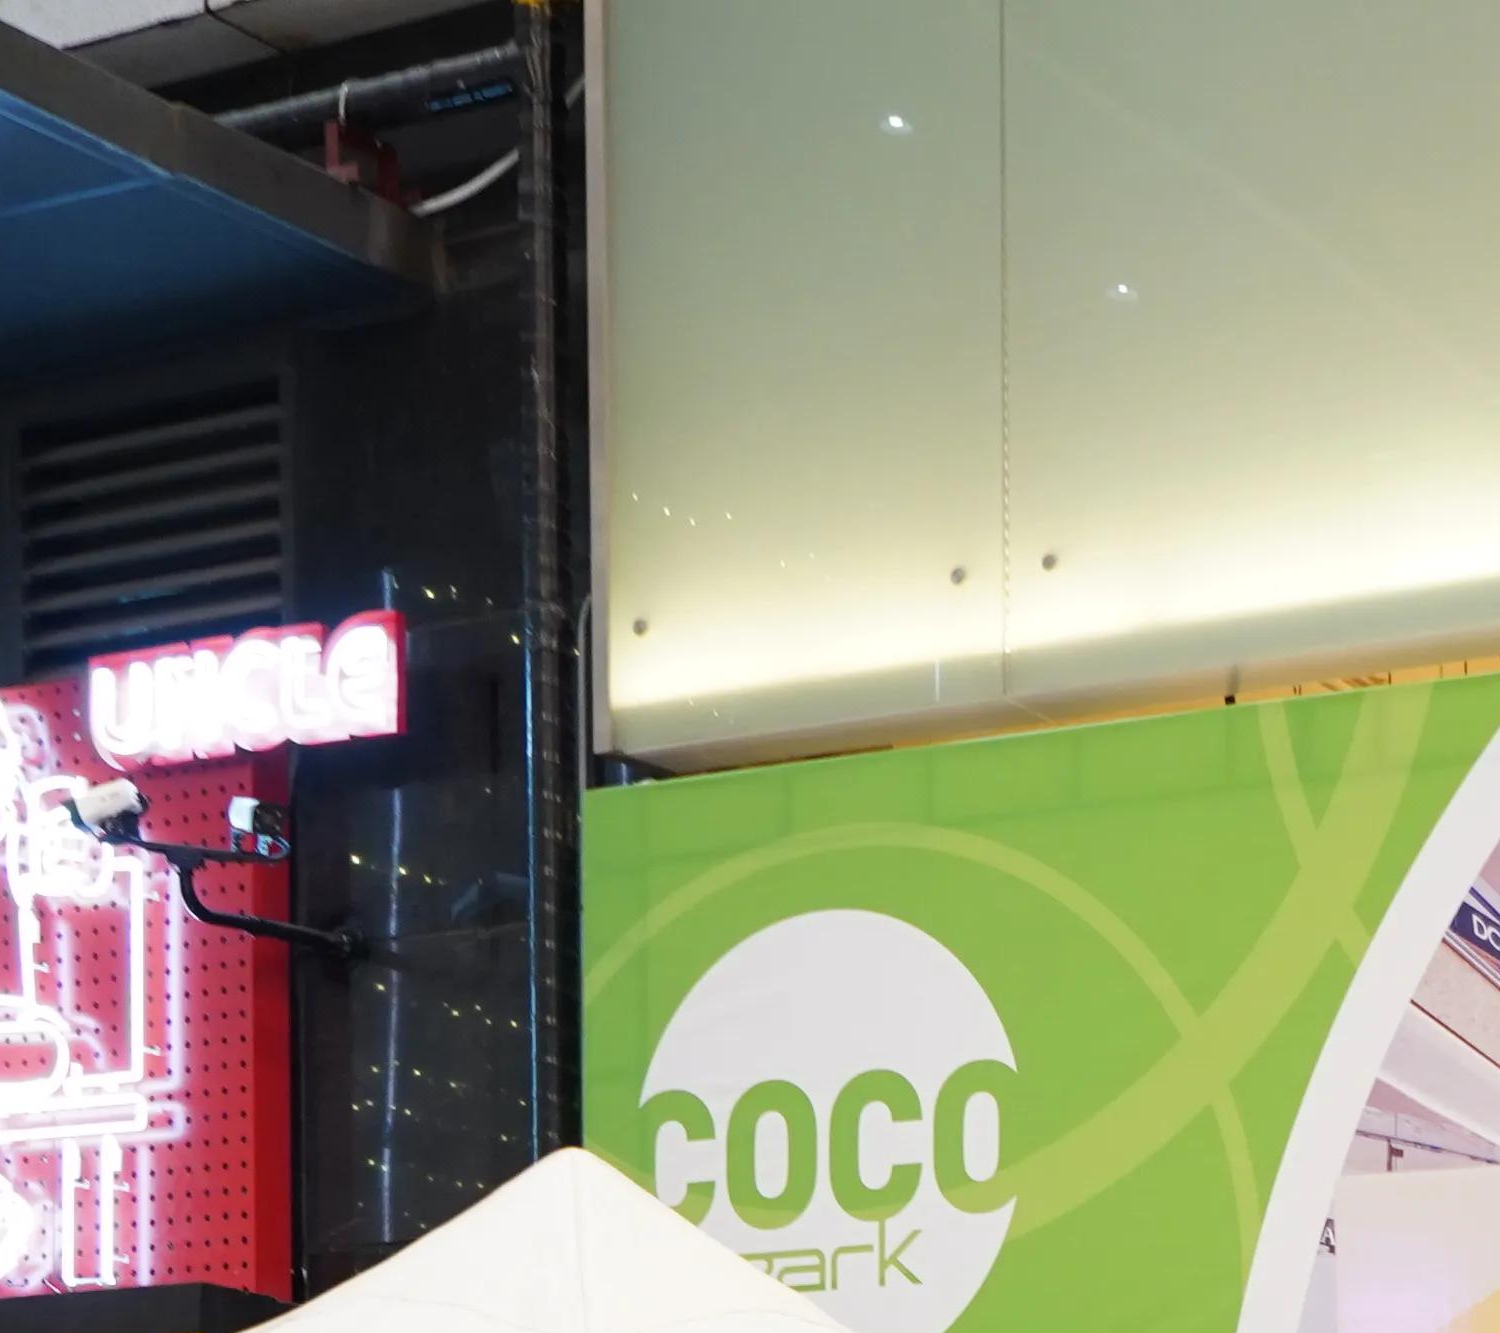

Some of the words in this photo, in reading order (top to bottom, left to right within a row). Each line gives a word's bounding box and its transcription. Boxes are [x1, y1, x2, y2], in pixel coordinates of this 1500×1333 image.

[91, 622, 390, 770] UNCLE
[639, 1058, 1018, 1230] COCO
[737, 1218, 923, 1294] ark
